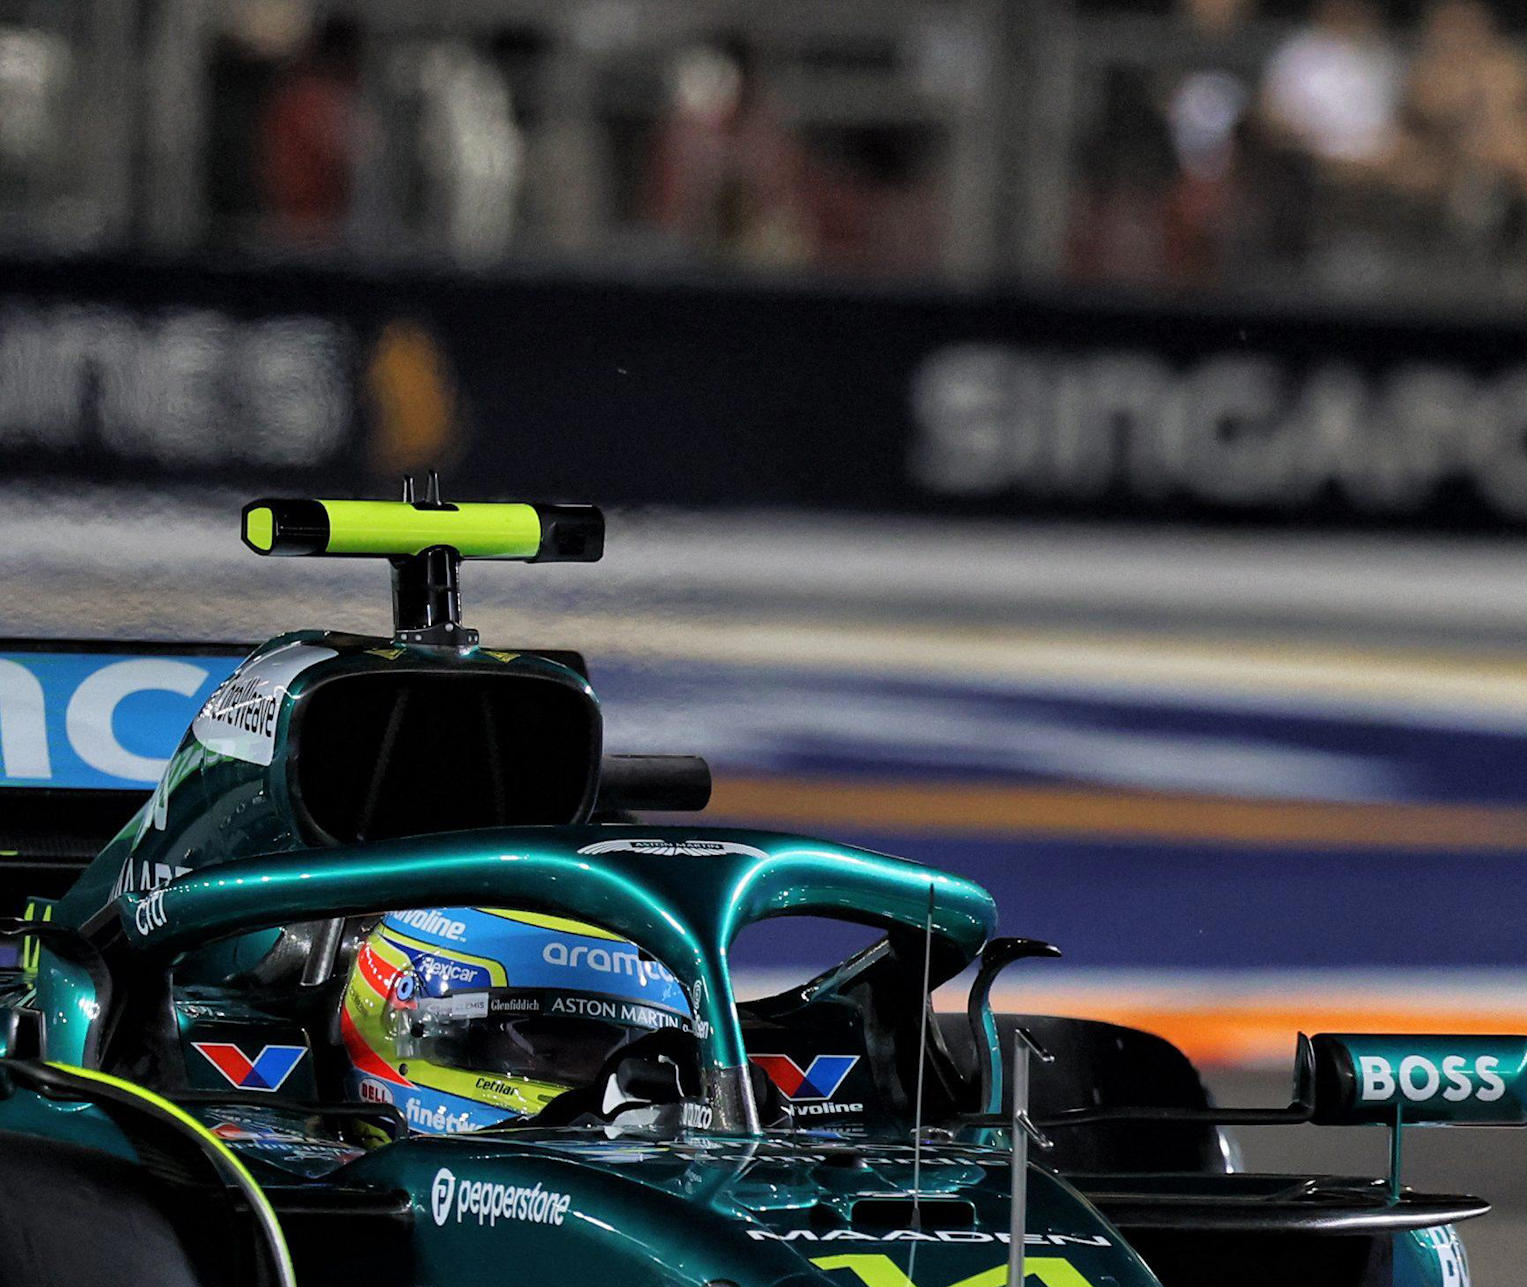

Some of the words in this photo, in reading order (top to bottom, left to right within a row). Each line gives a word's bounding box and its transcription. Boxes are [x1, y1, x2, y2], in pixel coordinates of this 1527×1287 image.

[490, 999, 539, 1011] Glenfiddich
[552, 997, 616, 1018] ASTON
[621, 1005, 678, 1028] MARTIN
[1359, 1054, 1507, 1102] BOSS
[361, 1083, 386, 1104] BELL
[457, 1180, 571, 1227] pepperstone
[745, 1229, 1113, 1248] MAADEN
